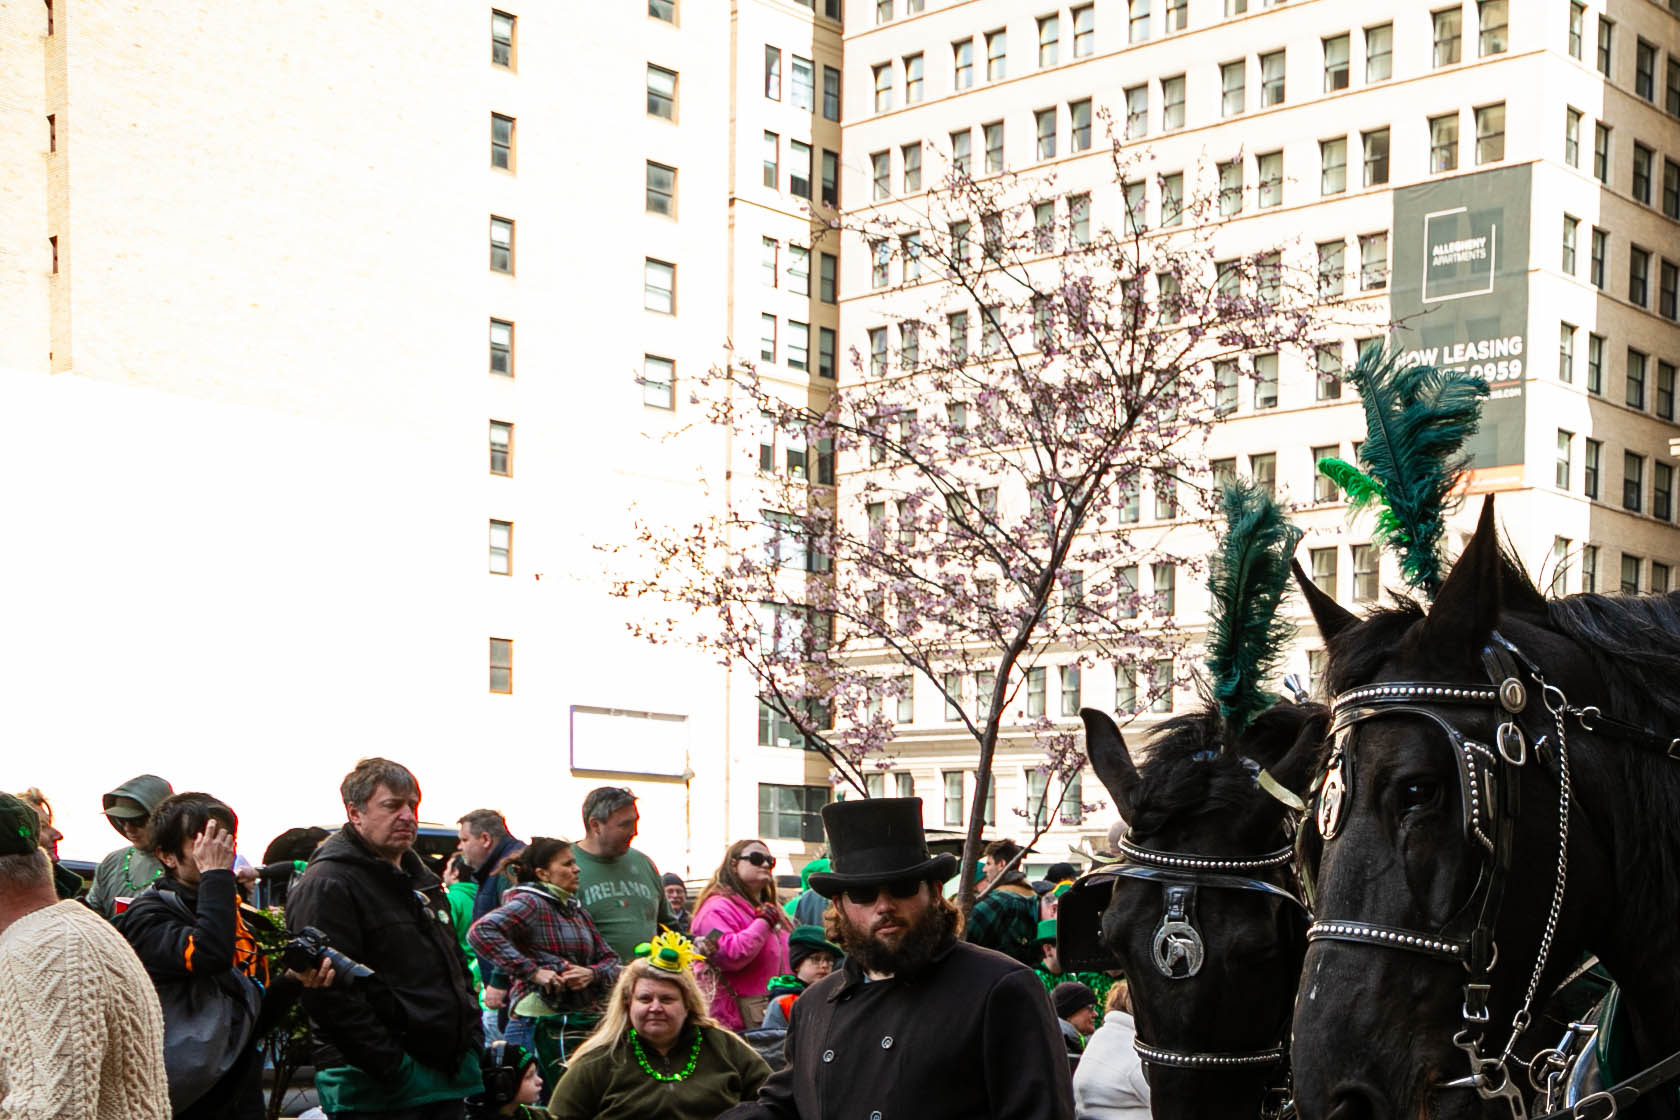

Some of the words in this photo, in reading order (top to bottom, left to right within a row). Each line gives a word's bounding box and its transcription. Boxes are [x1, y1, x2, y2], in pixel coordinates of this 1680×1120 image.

[1393, 347, 1439, 371] NOW
[1443, 336, 1523, 365] LEASING
[584, 880, 651, 905] IRELAND
